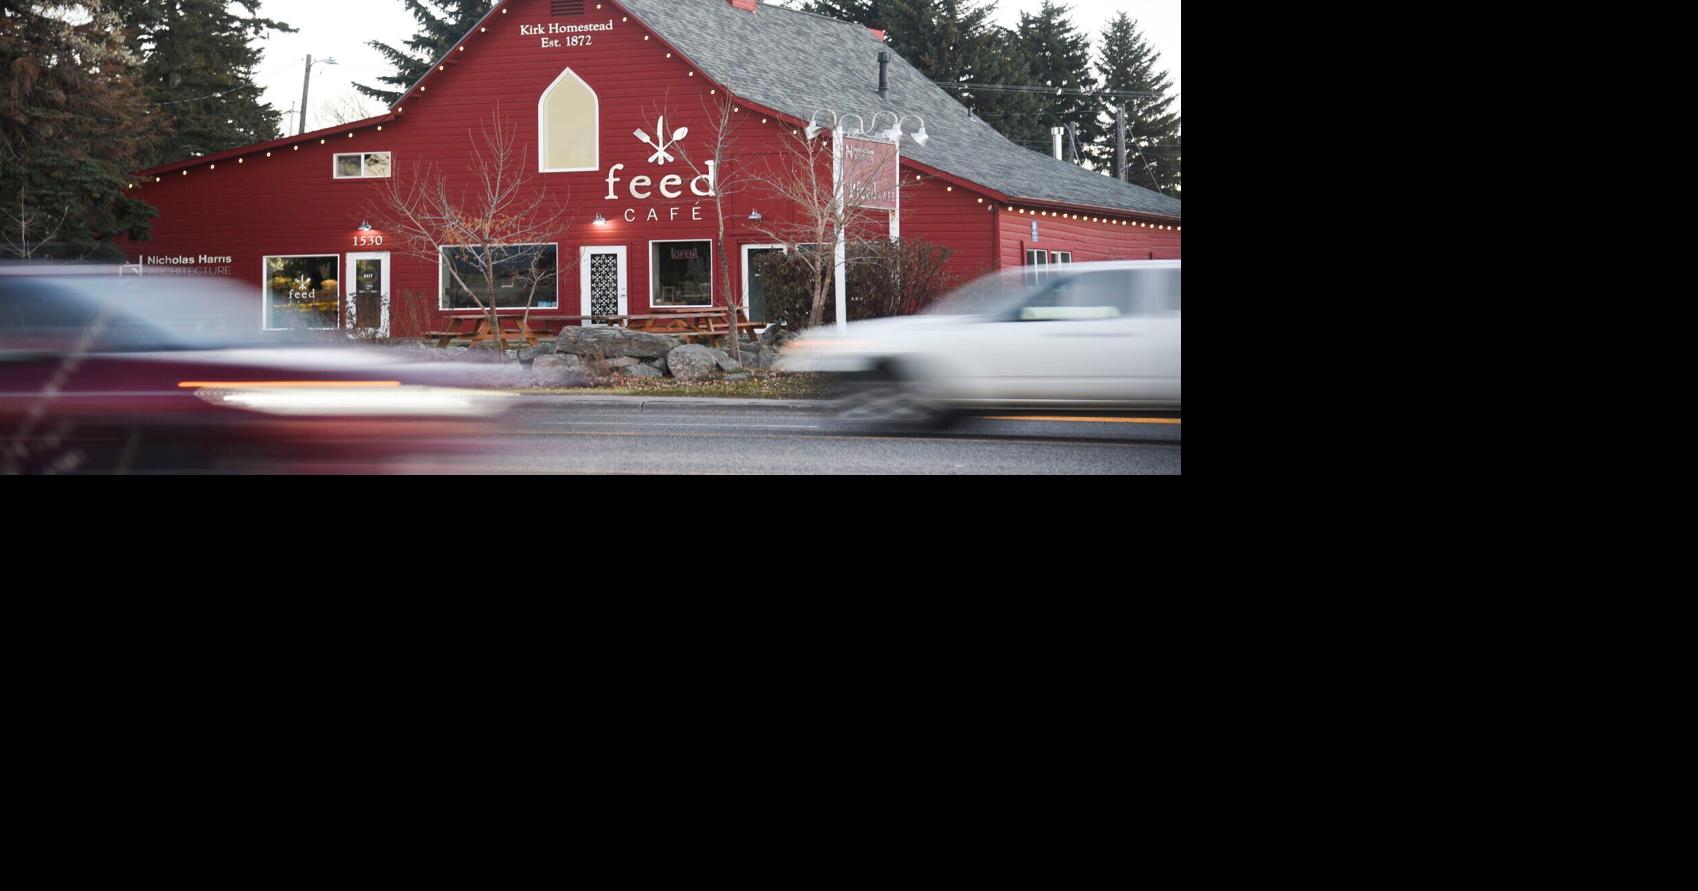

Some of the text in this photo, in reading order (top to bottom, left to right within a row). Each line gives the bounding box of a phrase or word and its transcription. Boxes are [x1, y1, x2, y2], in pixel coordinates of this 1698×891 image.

[520, 19, 614, 35] Kirk Homestead
[541, 34, 592, 48] Est. 1872
[604, 160, 716, 200] feed
[624, 201, 702, 222] CAFÉ
[352, 235, 383, 247] 1530
[147, 254, 232, 265] Nicholas Harris
[288, 288, 315, 299] feed
